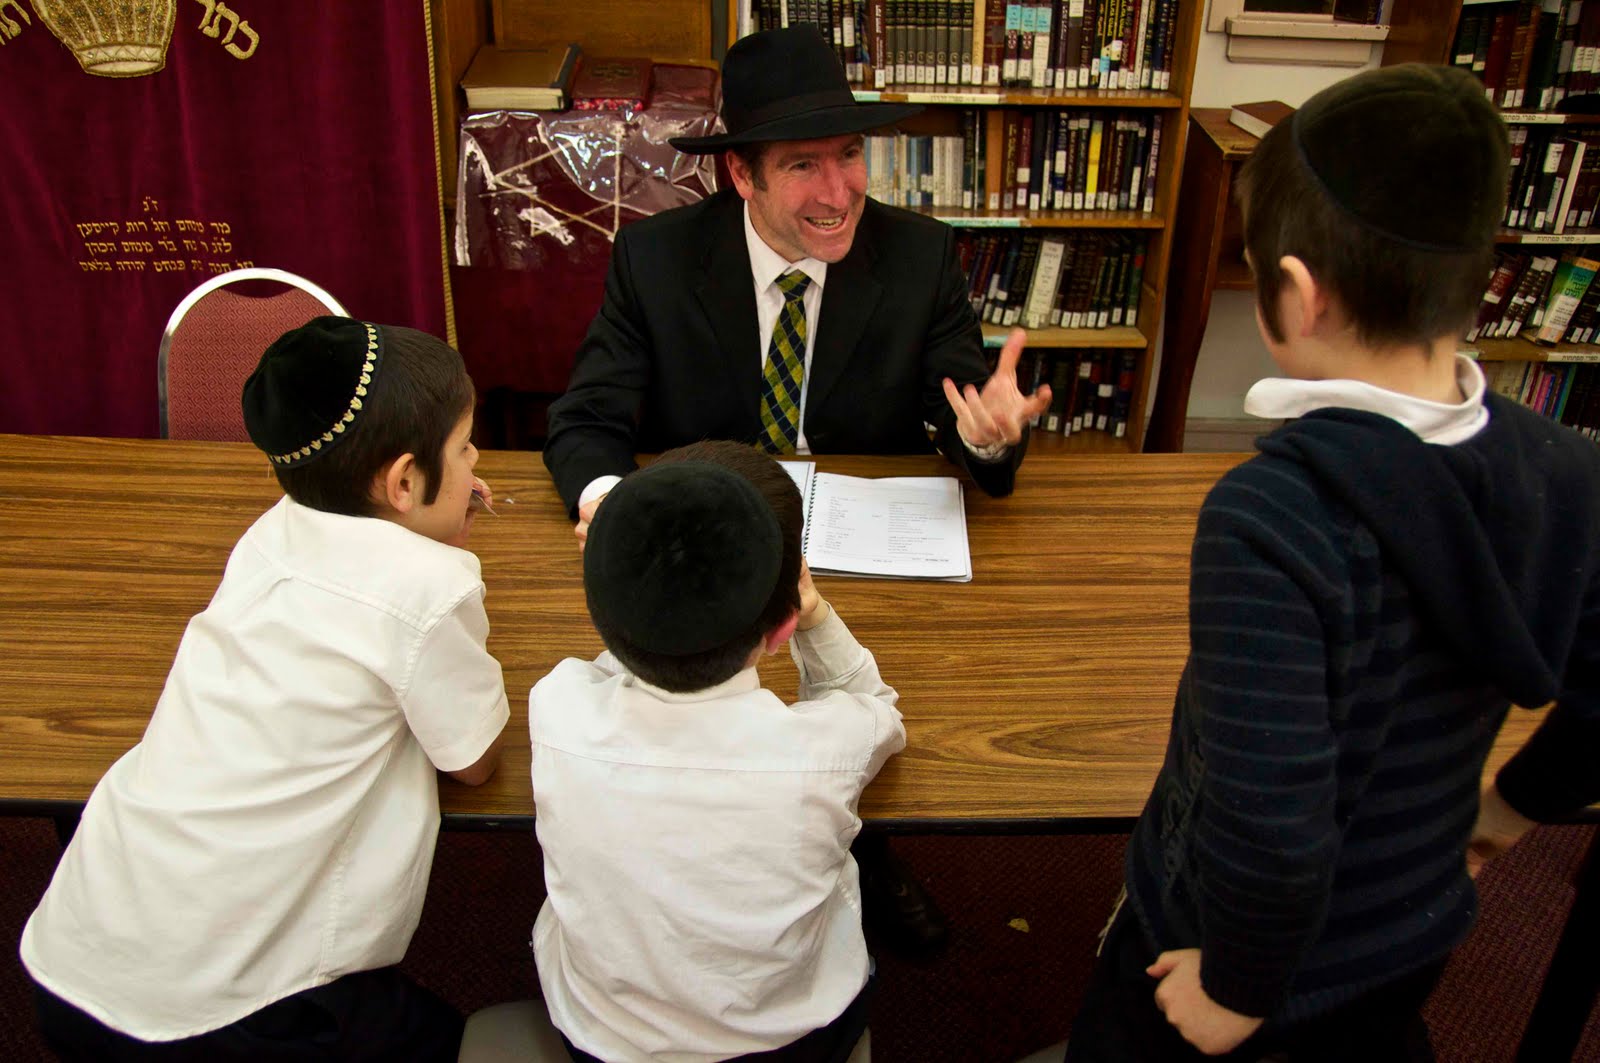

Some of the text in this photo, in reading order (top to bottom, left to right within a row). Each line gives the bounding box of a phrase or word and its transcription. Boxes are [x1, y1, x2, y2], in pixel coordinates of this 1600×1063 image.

[195, 0, 260, 60] כתר
[126, 221, 148, 233] רות
[210, 222, 231, 234] מר
[84, 242, 117, 256] הכהן
[121, 240, 154, 253] מנחם
[115, 260, 146, 271] יהודה
[153, 260, 186, 272] פנחס
